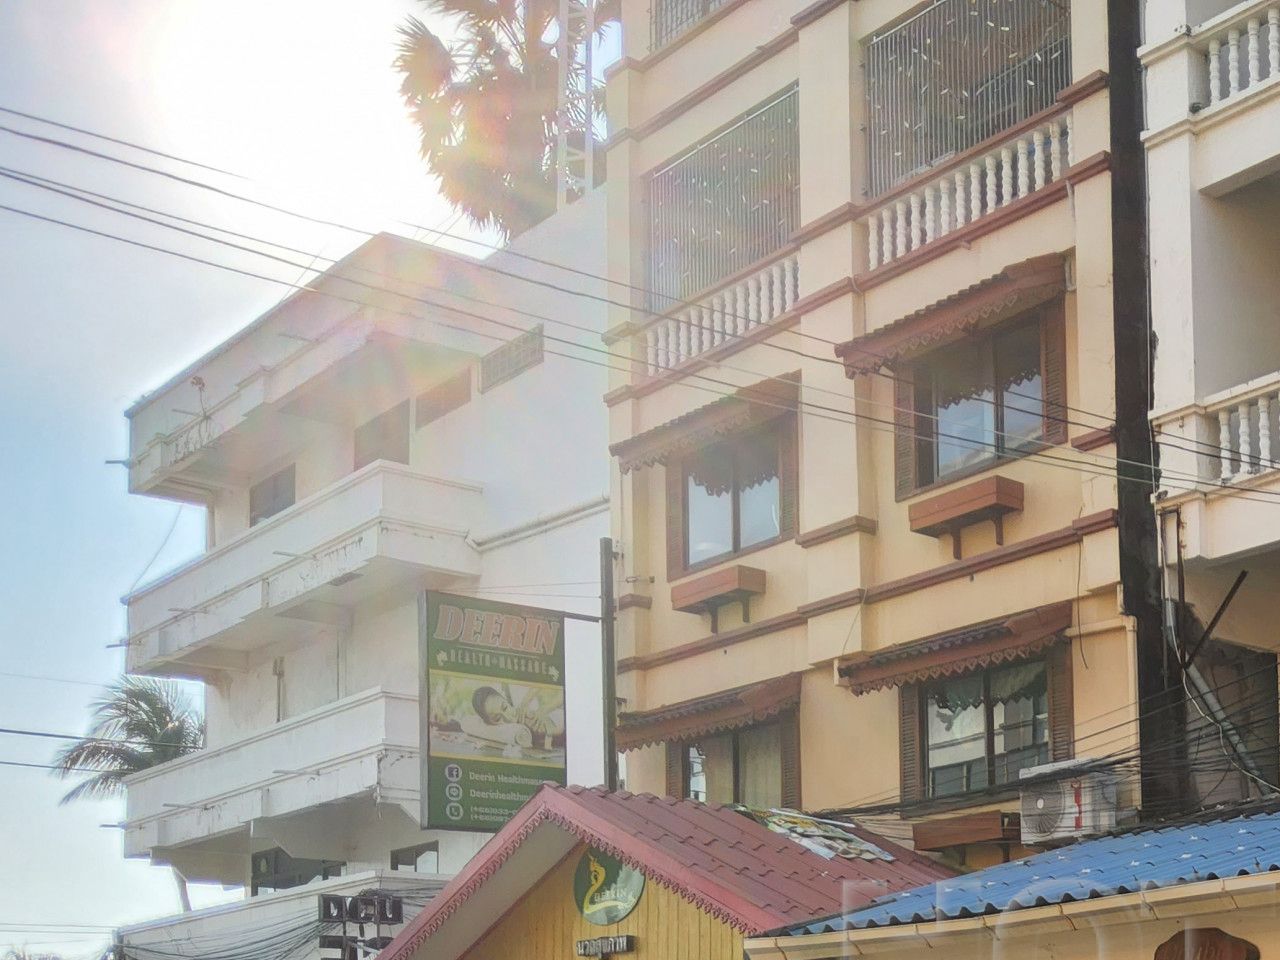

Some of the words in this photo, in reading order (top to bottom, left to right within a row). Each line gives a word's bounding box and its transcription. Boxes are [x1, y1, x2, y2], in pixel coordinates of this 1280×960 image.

[434, 604, 561, 656] DEERIN
[469, 771, 496, 782] Deerin
[469, 788, 530, 801] Deerinhealthm
